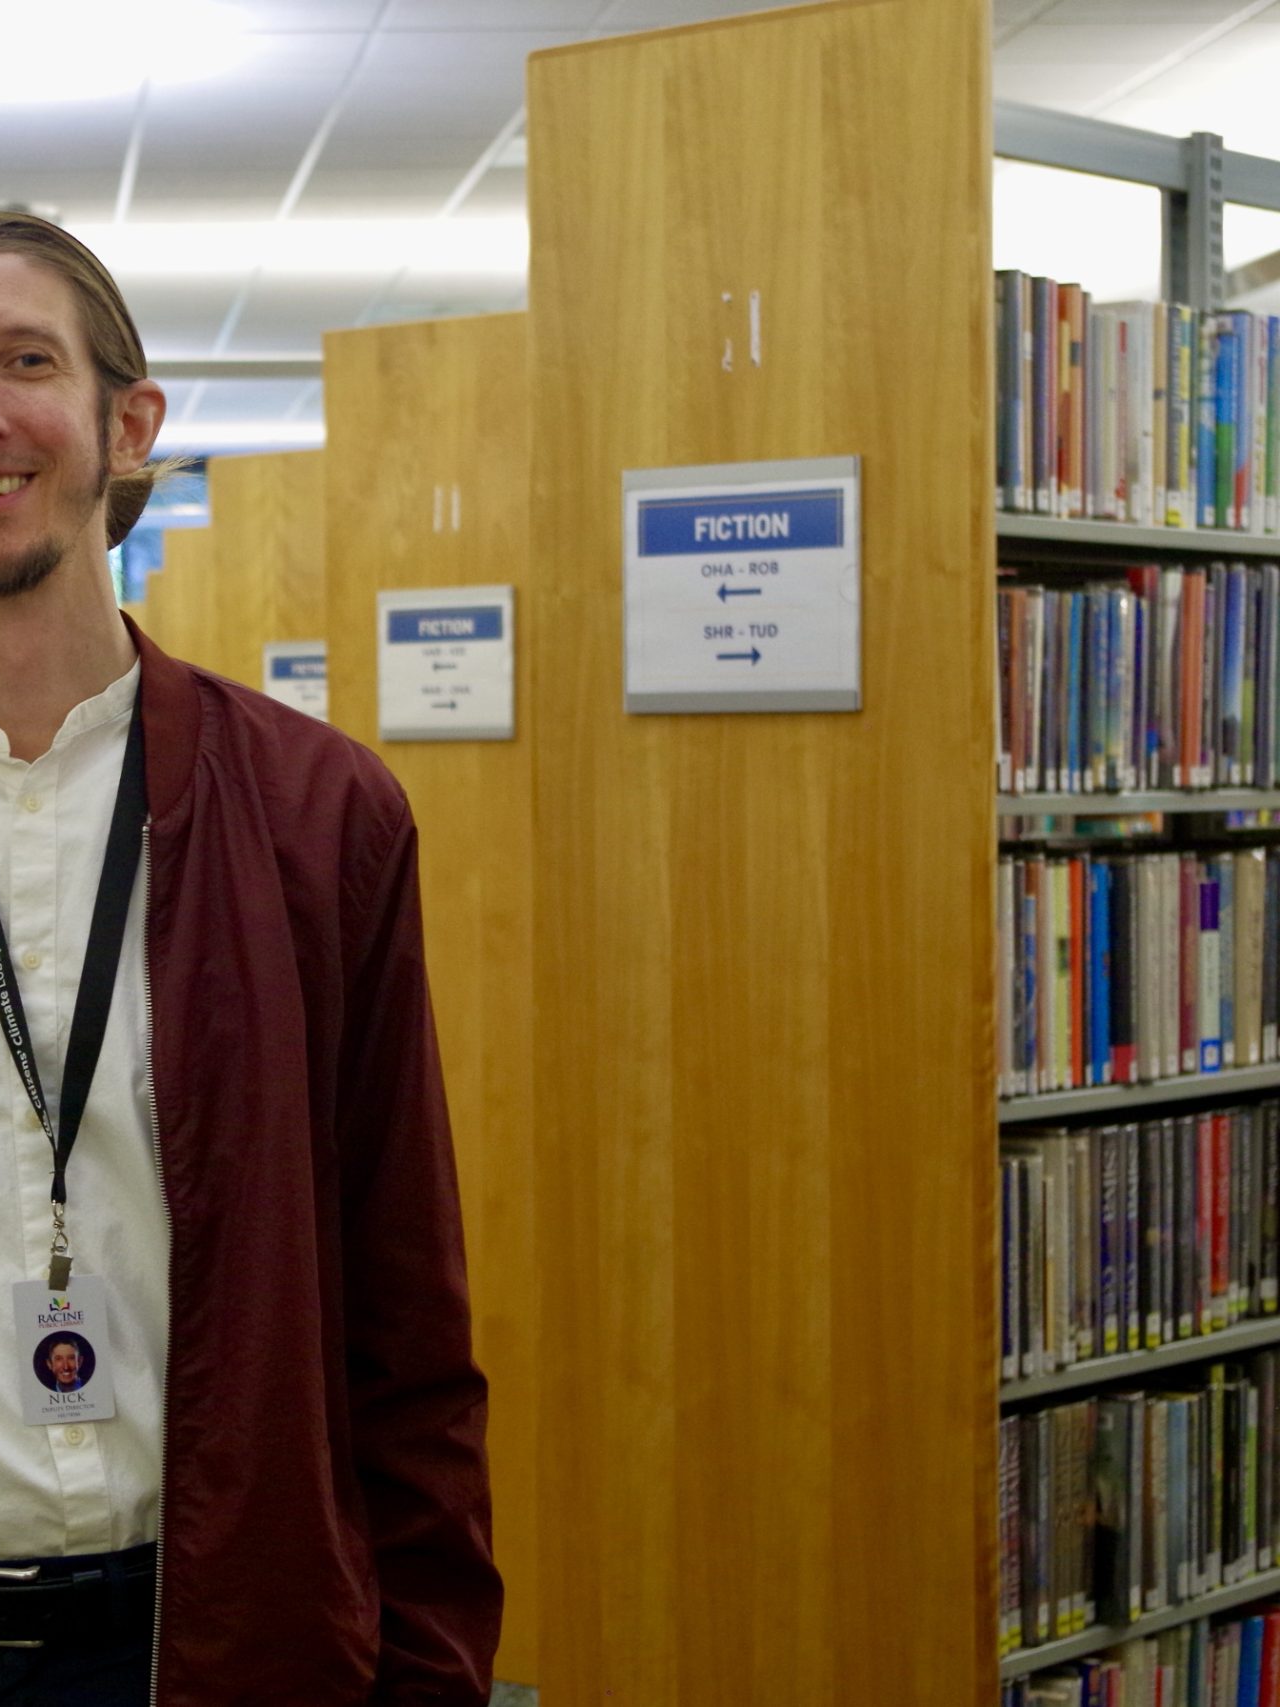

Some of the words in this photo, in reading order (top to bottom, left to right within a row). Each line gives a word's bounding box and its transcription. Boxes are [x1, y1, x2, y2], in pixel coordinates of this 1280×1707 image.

[693, 512, 790, 542] FICTION
[700, 563, 734, 578] OHA
[748, 561, 780, 575] ROB
[417, 616, 476, 637] FICTION
[703, 625, 734, 640] SHR
[748, 623, 779, 638] TUD
[290, 662, 326, 676] FICTIO
[0, 989, 23, 1046] Climate
[38, 1311, 85, 1324] RACINE
[49, 1392, 86, 1405] NICK
